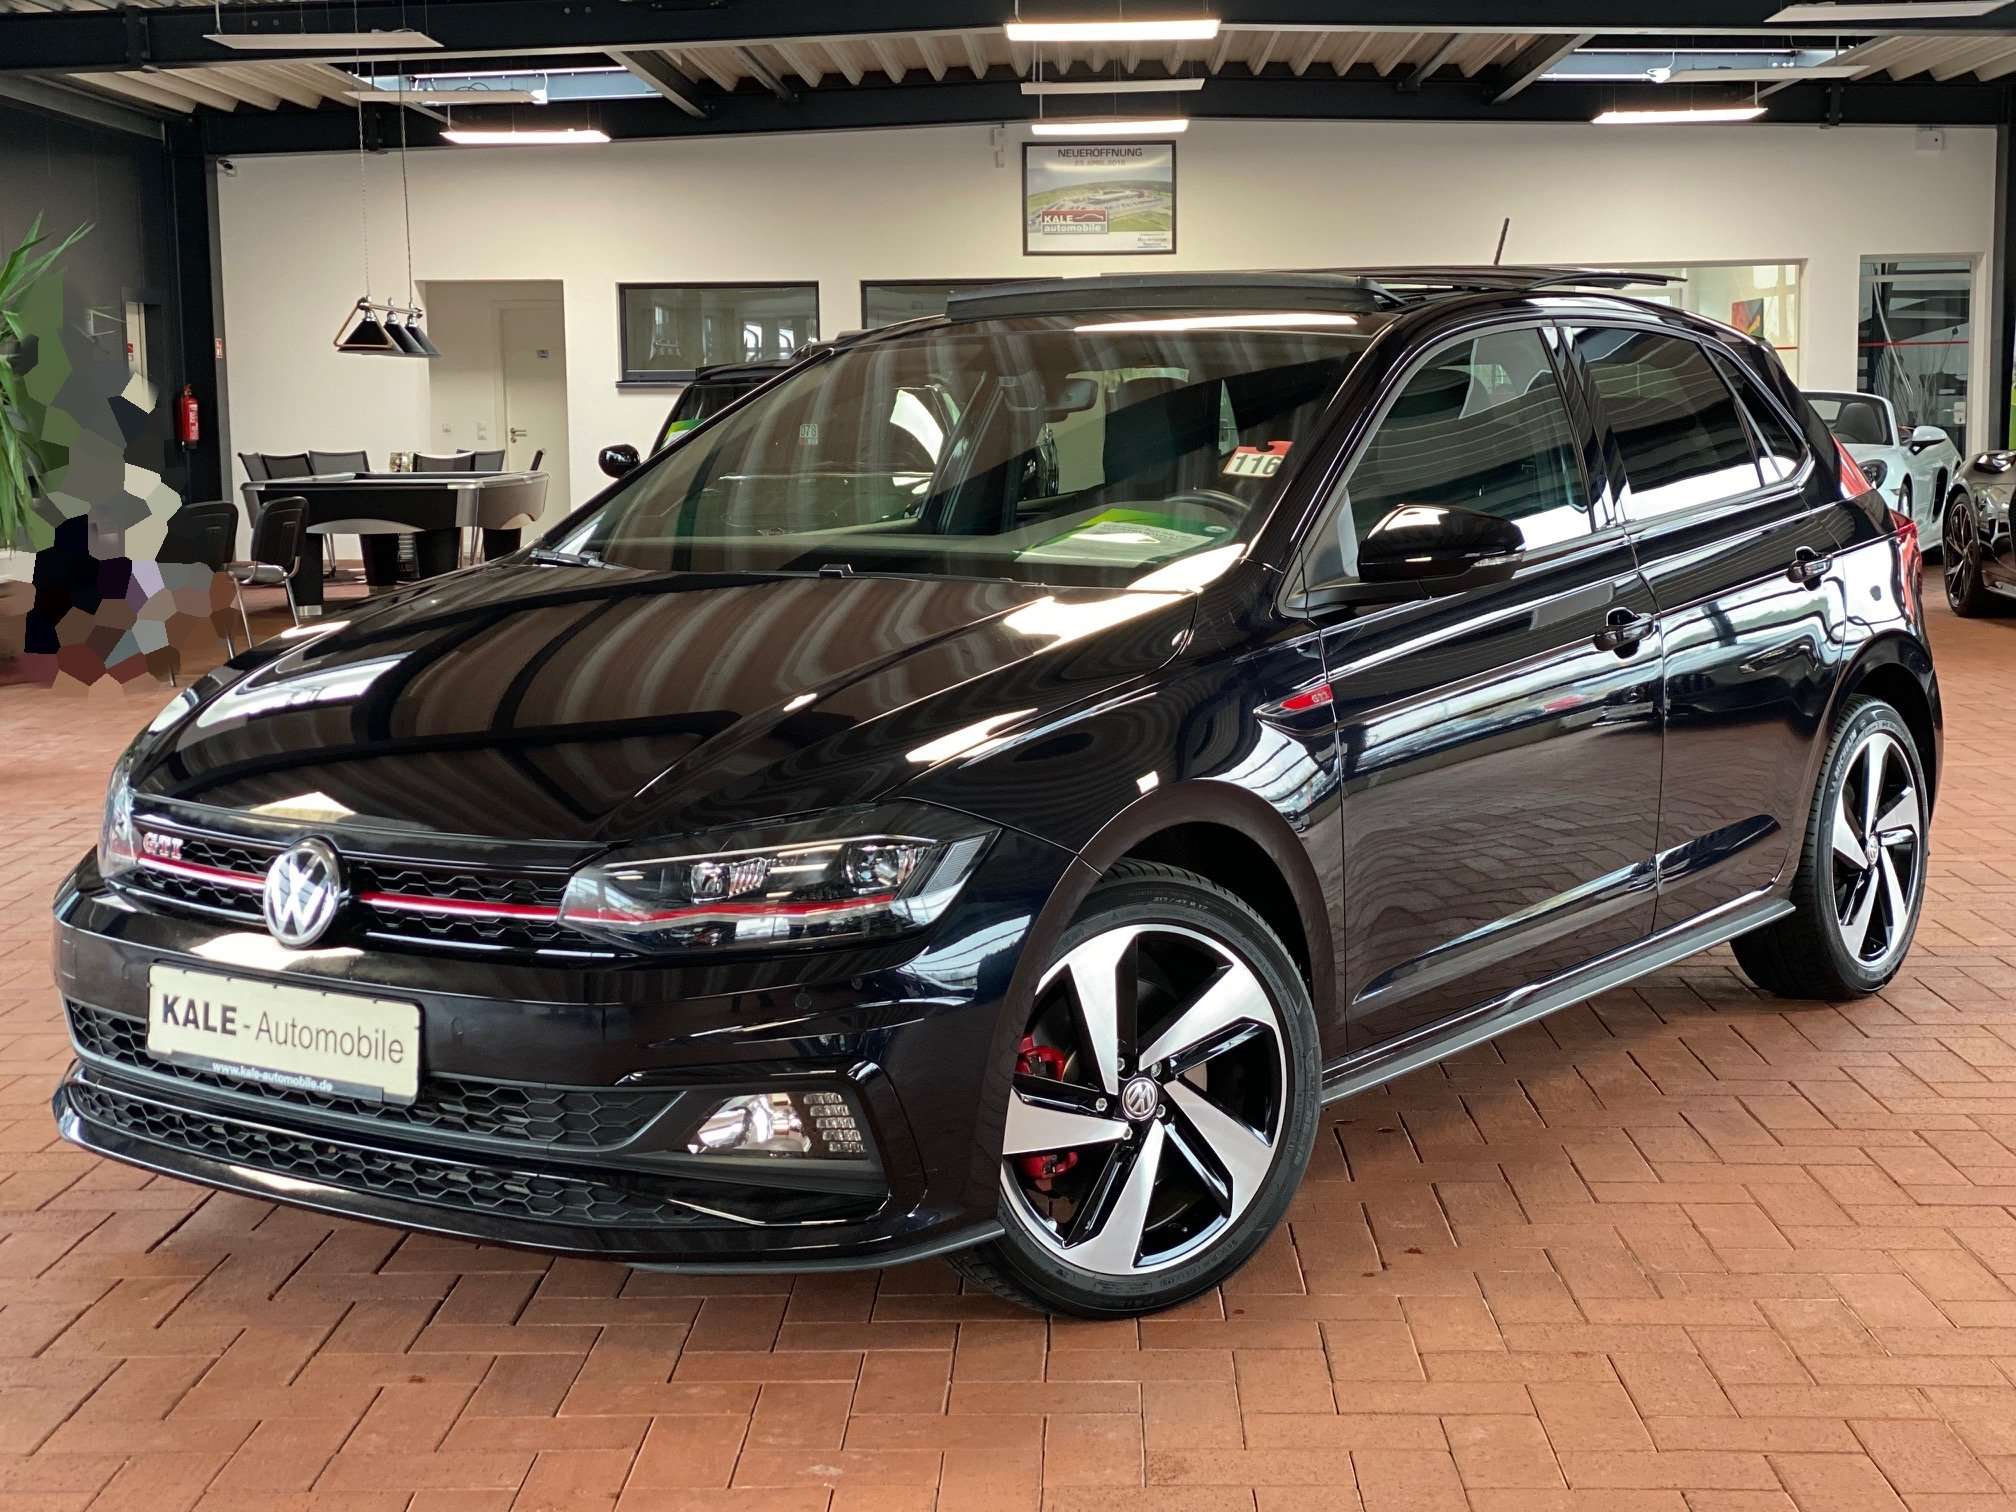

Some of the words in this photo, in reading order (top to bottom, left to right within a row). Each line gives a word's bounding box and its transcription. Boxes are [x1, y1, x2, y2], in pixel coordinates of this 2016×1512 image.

[1044, 215, 1073, 224] KALE
[1044, 223, 1102, 233] automobile
[1233, 454, 1282, 475] 116
[143, 832, 184, 860] GTI
[211, 1061, 334, 1092] www.kale-automobile.de
